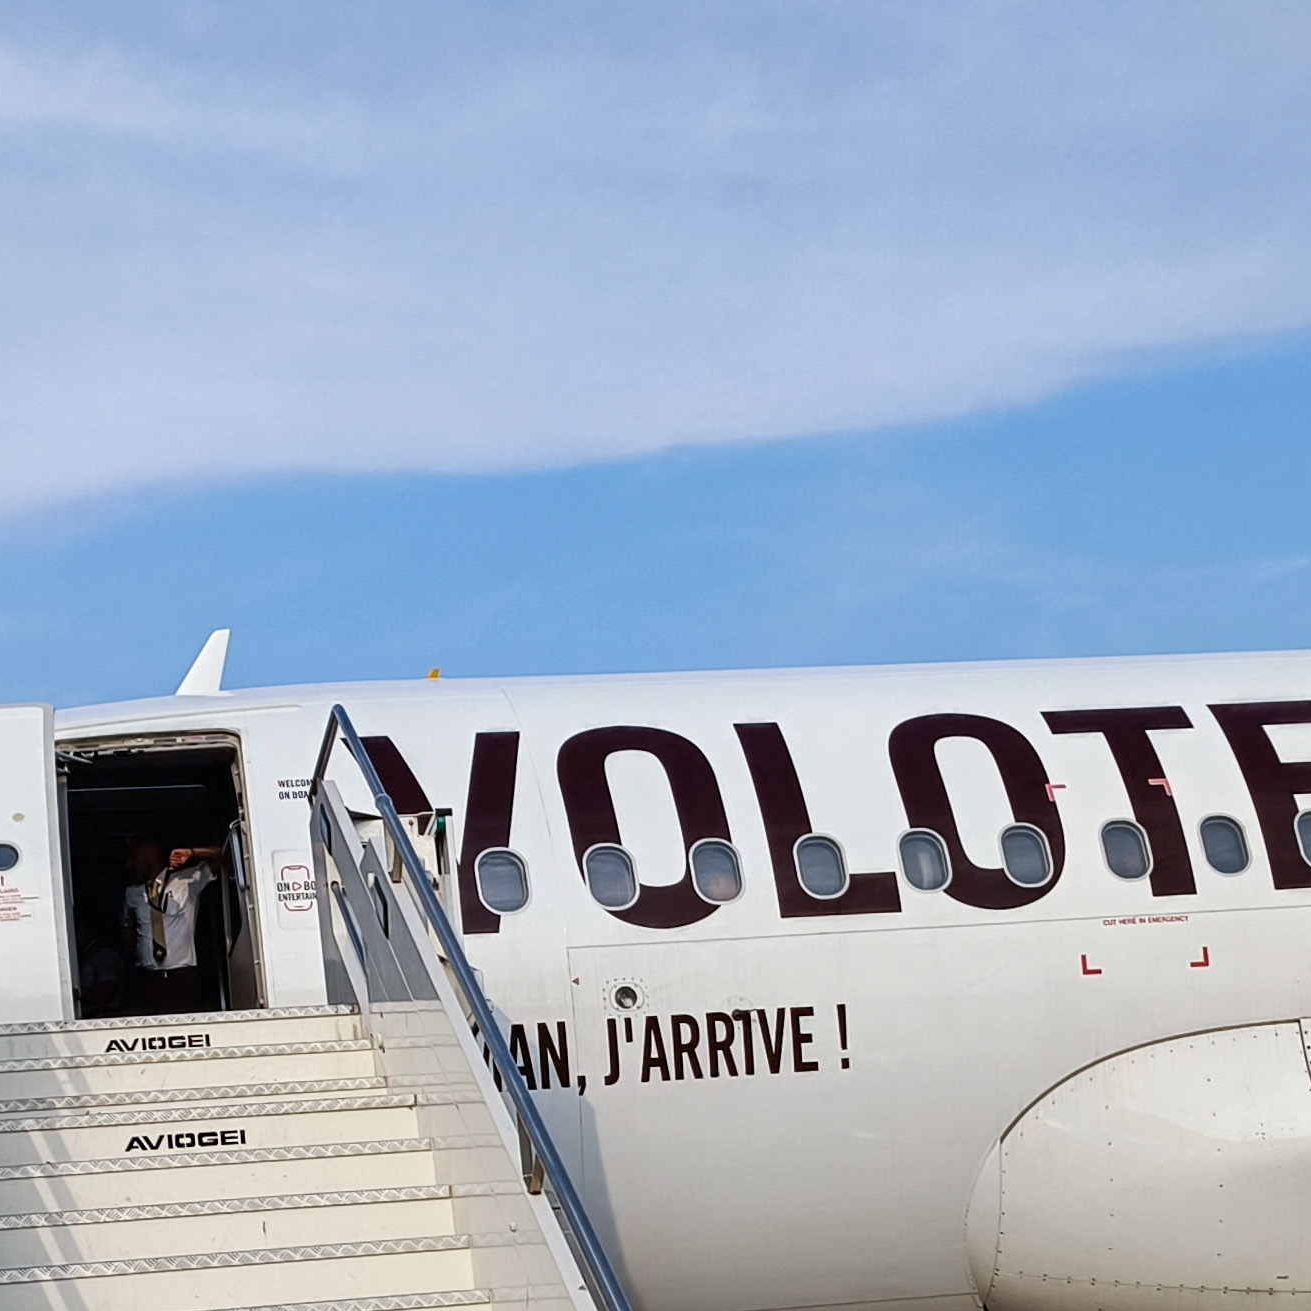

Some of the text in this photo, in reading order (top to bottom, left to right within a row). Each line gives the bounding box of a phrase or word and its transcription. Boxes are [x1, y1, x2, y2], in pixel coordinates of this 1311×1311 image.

[279, 791, 290, 800] ON
[277, 882, 290, 892] ON
[105, 1034, 210, 1053] AVIOGEI
[604, 1006, 819, 1086] J'ARRIVE
[125, 1129, 247, 1152] AVIOGEI
